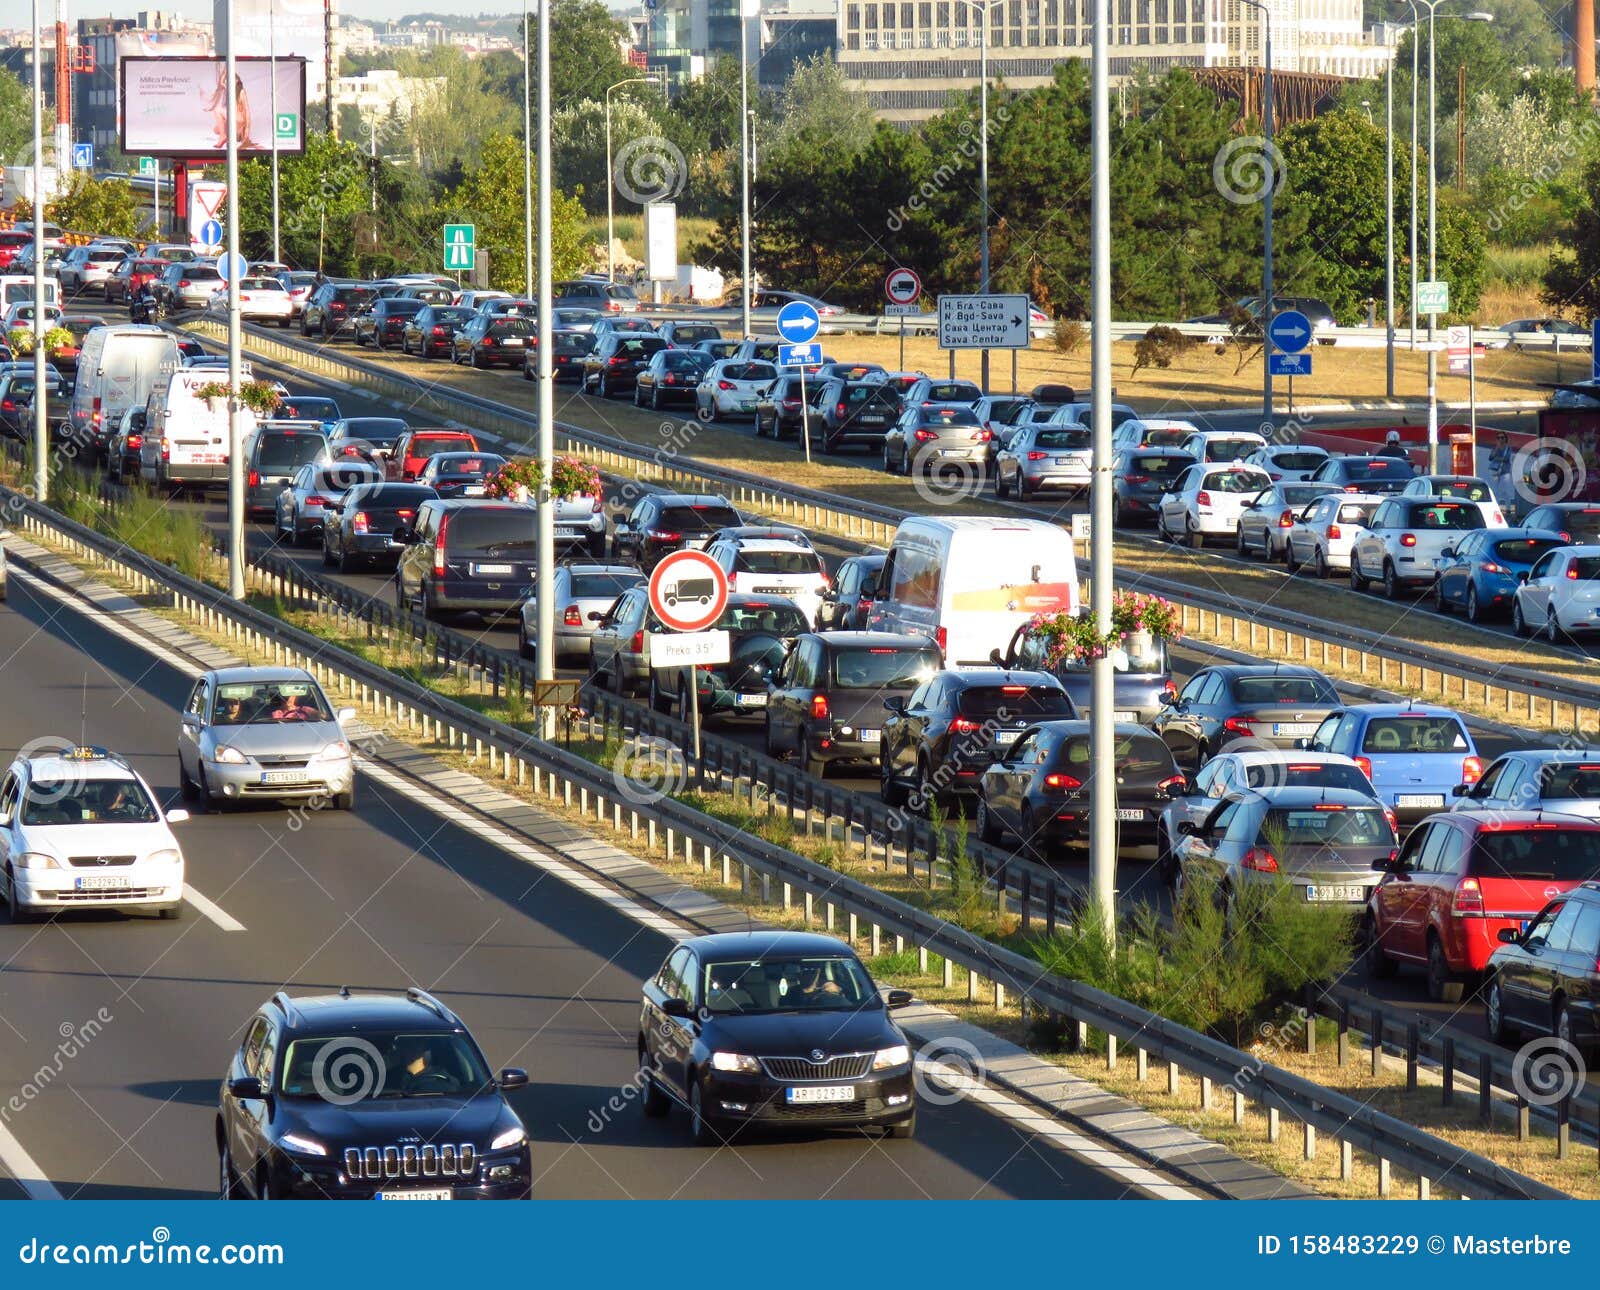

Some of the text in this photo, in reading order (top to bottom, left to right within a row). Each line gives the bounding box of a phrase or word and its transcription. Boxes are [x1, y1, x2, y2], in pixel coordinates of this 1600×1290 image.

[957, 311, 1004, 321] Bgd-Sava
[944, 323, 1008, 333] Сава Центар
[944, 335, 1005, 344] Sava Centar
[666, 645, 691, 656] Preko
[82, 878, 93, 887] BG
[795, 1089, 807, 1100] AR
